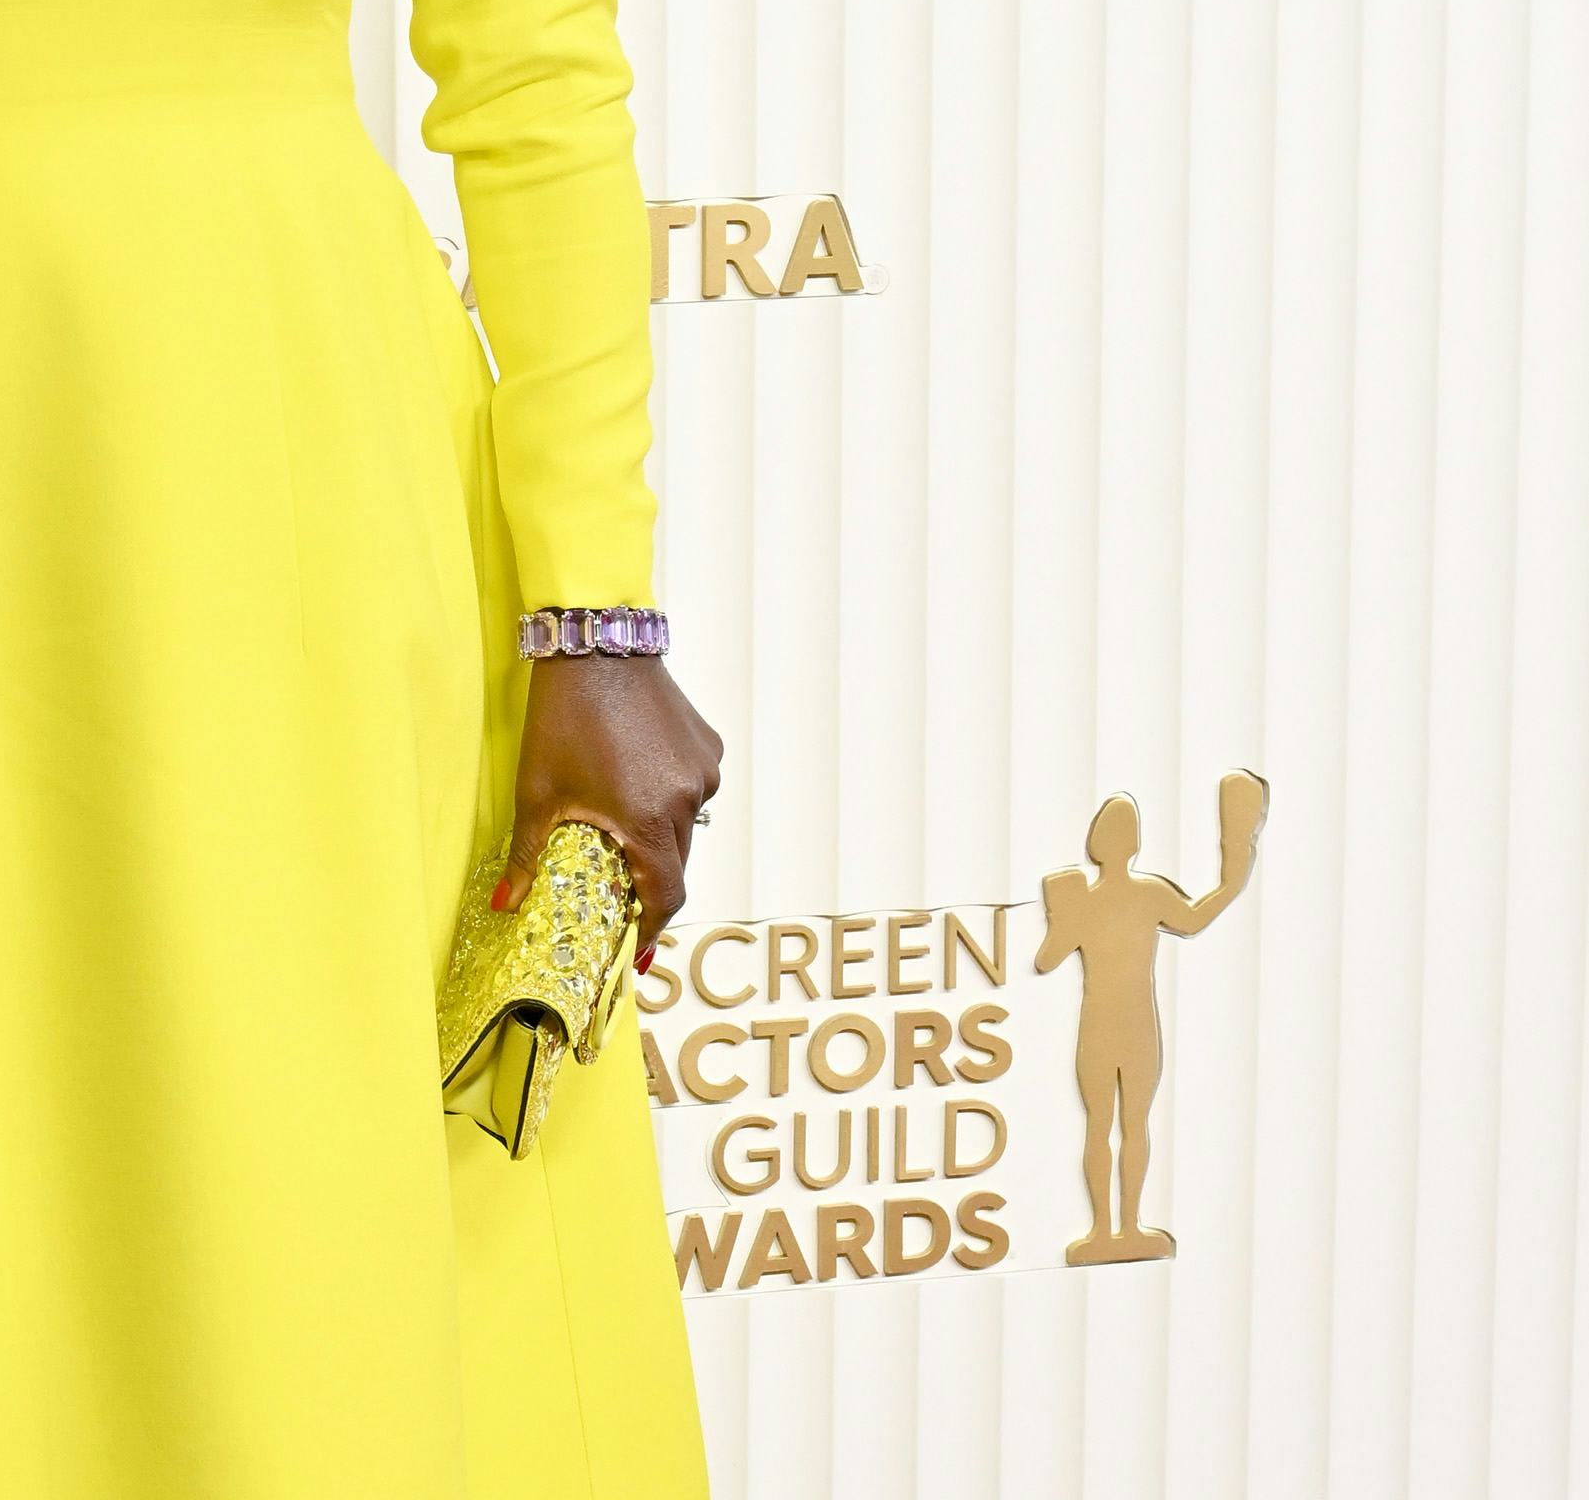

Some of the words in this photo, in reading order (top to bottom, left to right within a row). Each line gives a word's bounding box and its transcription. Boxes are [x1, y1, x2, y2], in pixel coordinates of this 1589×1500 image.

[635, 910, 1007, 1015] SCREEN
[711, 1098, 1008, 1196] GUILD
[674, 1190, 1009, 1293] WARDS
